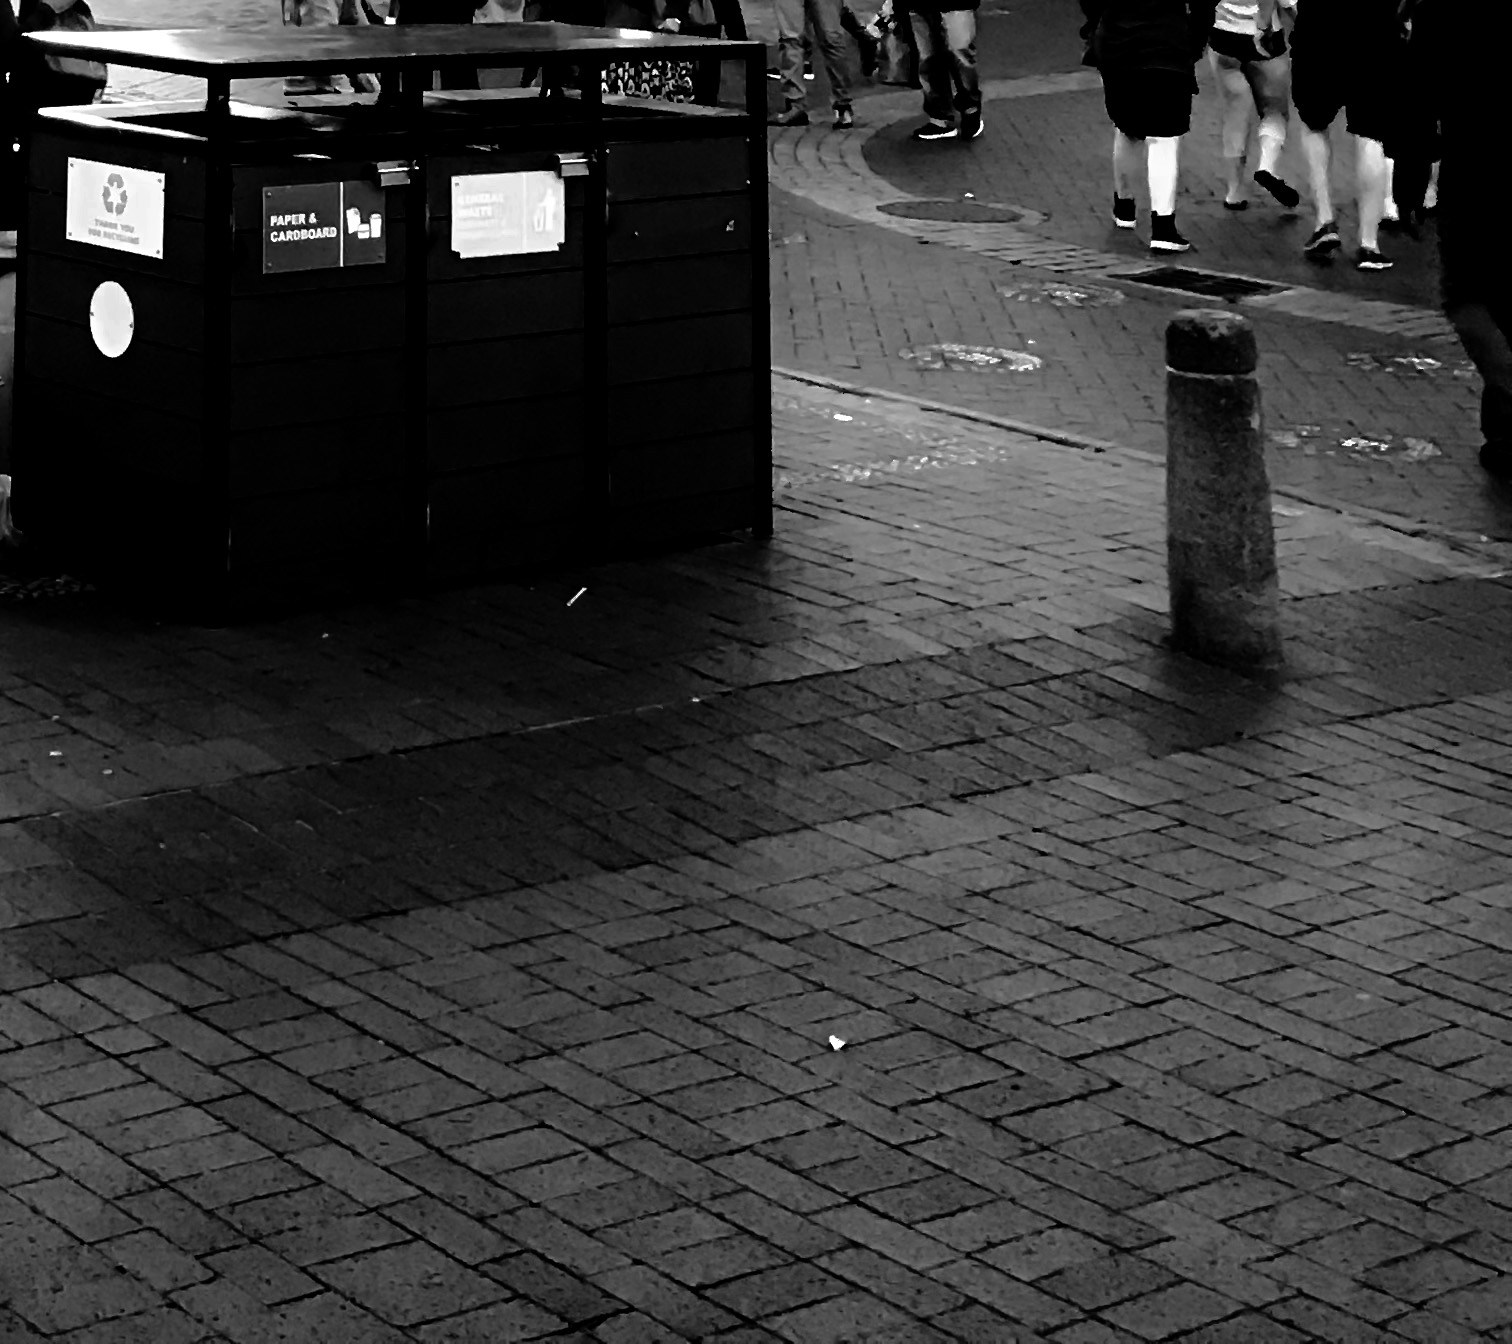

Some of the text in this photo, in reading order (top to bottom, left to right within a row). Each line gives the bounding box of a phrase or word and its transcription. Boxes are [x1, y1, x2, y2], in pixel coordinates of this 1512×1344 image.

[270, 212, 317, 226] PAPER &
[270, 226, 338, 243] CARDBOARD
